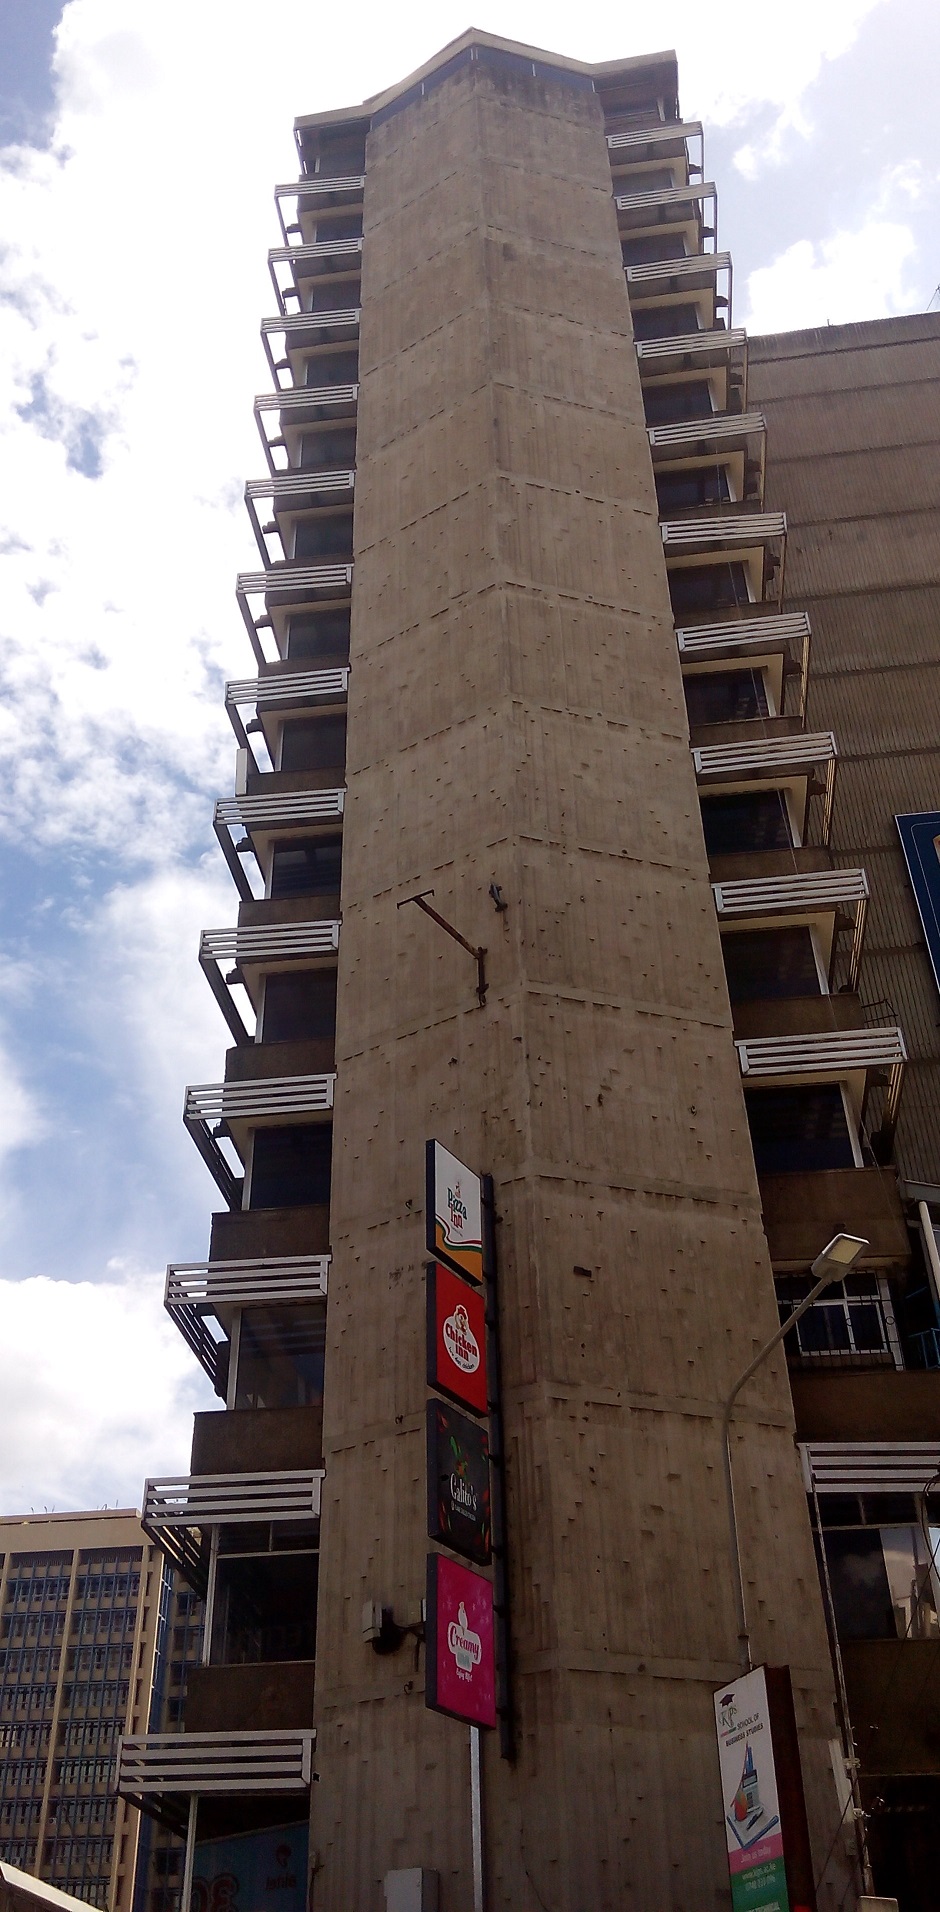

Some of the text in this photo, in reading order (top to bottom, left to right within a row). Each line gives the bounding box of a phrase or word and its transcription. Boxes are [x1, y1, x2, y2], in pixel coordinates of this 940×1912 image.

[447, 1187, 468, 1220] Pizza
[450, 1203, 463, 1229] Inn
[445, 1322, 478, 1358] Chicken
[450, 1473, 478, 1511] Galito's
[450, 1626, 479, 1660] Creamy
[725, 1722, 764, 1747] BUSINESS STUDIES
[737, 1712, 760, 1730] SCHOOL OF
